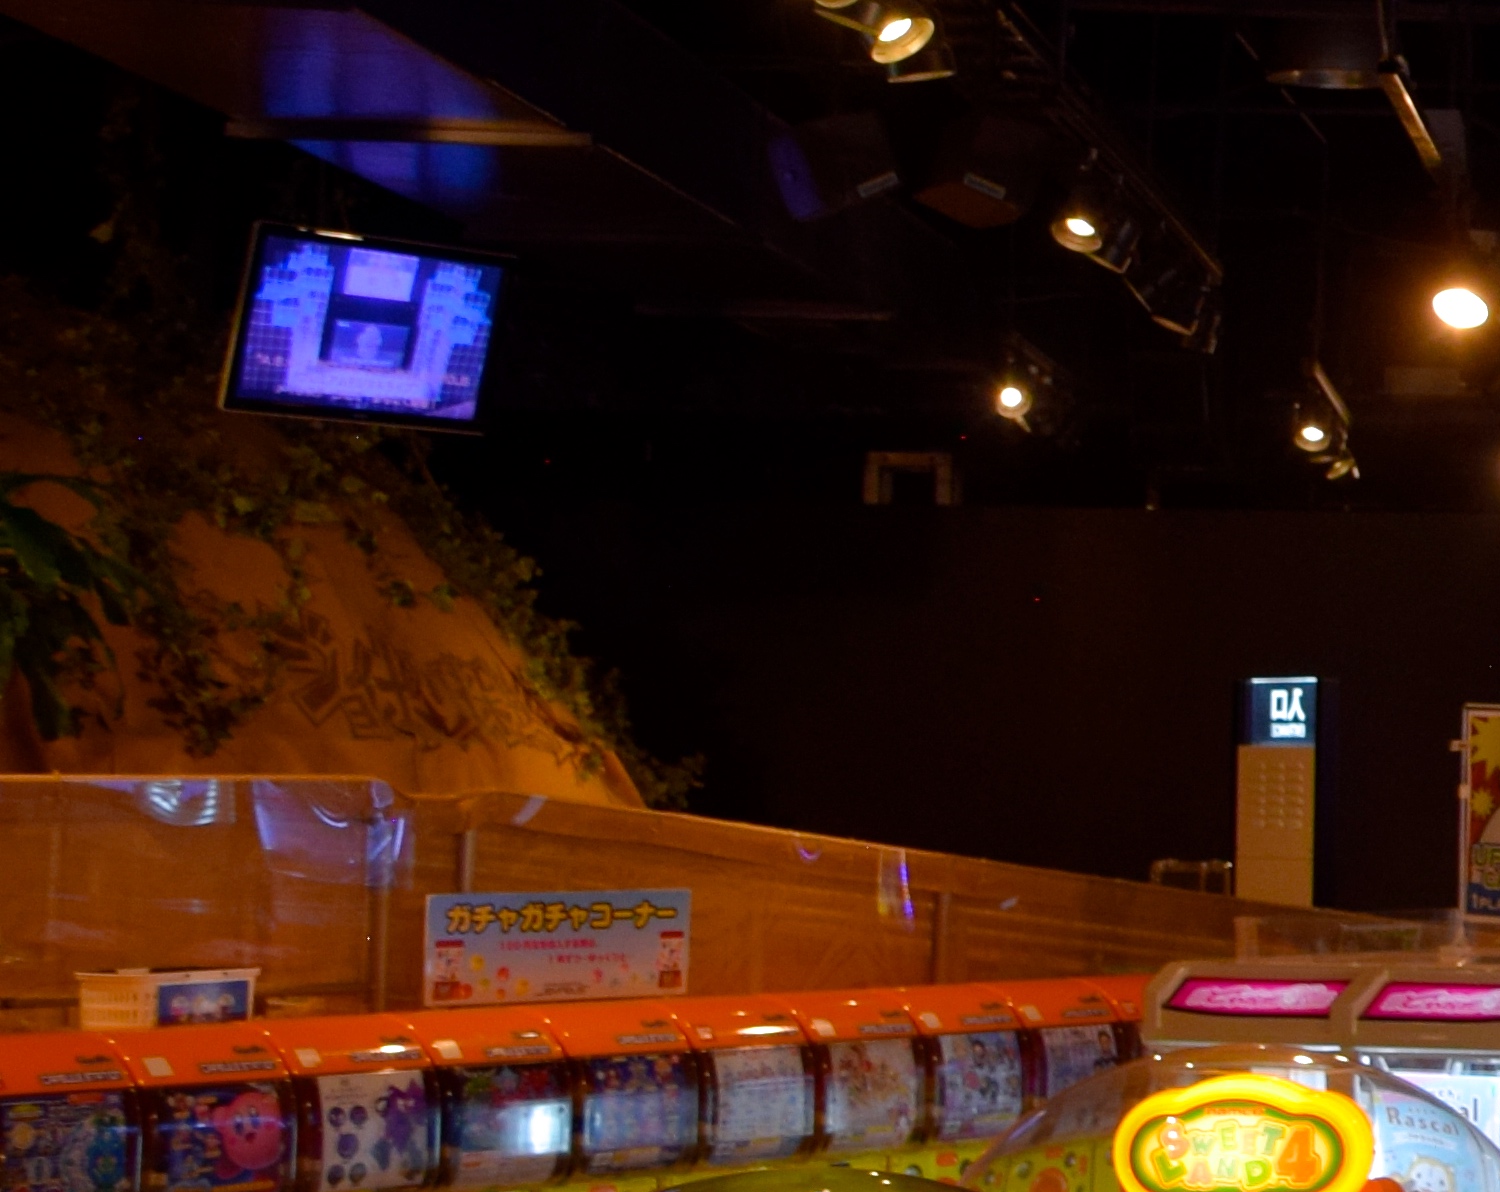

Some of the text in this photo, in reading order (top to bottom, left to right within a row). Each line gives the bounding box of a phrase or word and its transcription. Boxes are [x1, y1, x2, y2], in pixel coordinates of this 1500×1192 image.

[446, 899, 678, 934] ガチャガチャコーナー
[1160, 1118, 1286, 1160] SWEET
[1386, 1106, 1460, 1136] Rascal
[1155, 1124, 1320, 1187] LAND 4
